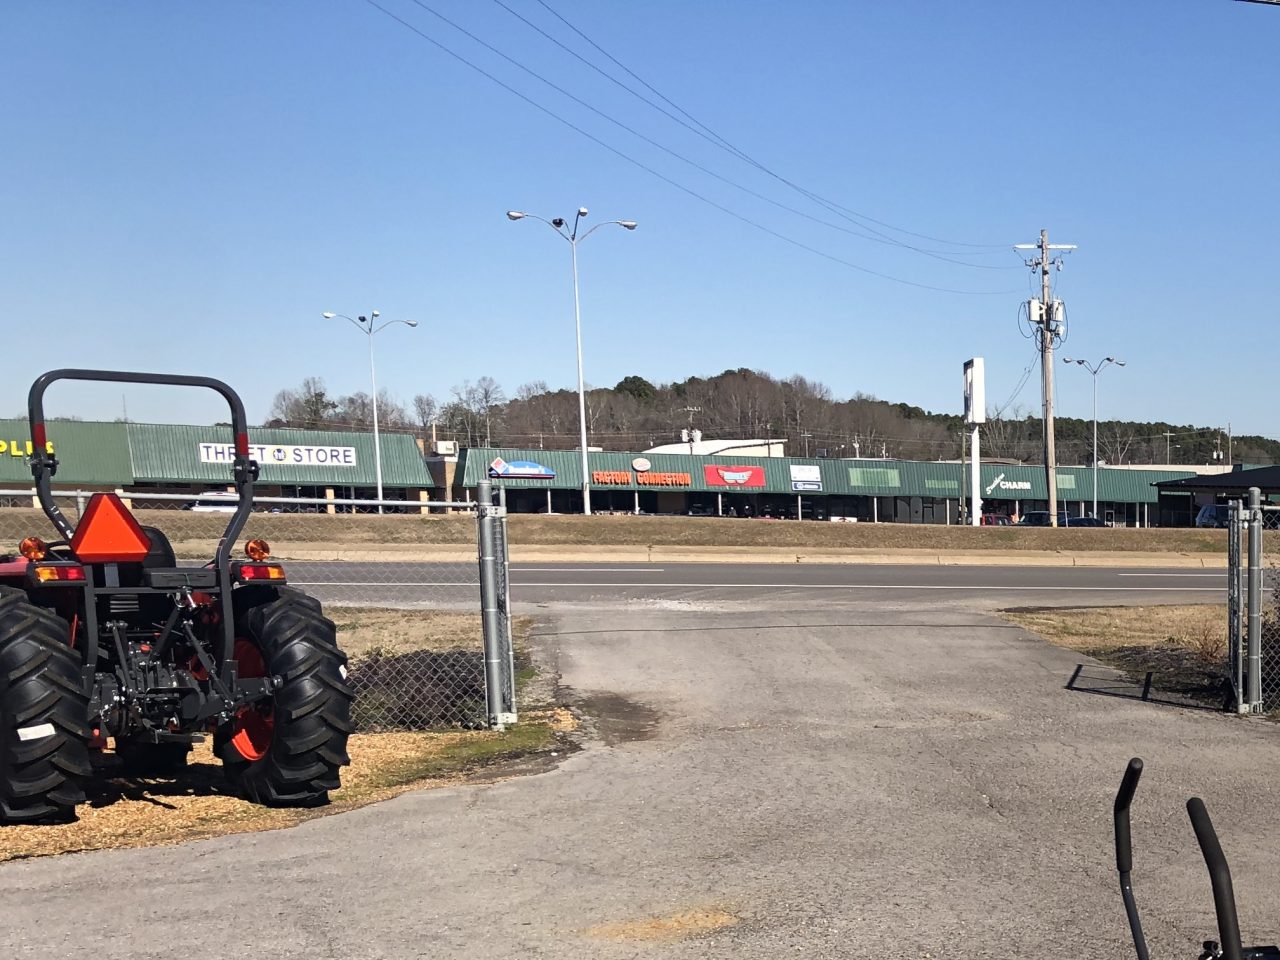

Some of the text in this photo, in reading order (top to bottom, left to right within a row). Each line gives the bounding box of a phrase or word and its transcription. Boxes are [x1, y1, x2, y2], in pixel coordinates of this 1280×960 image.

[202, 445, 353, 464] THRFT STORE
[592, 471, 691, 486] FACTORY CONNECTION
[1000, 481, 1031, 490] CHARM
